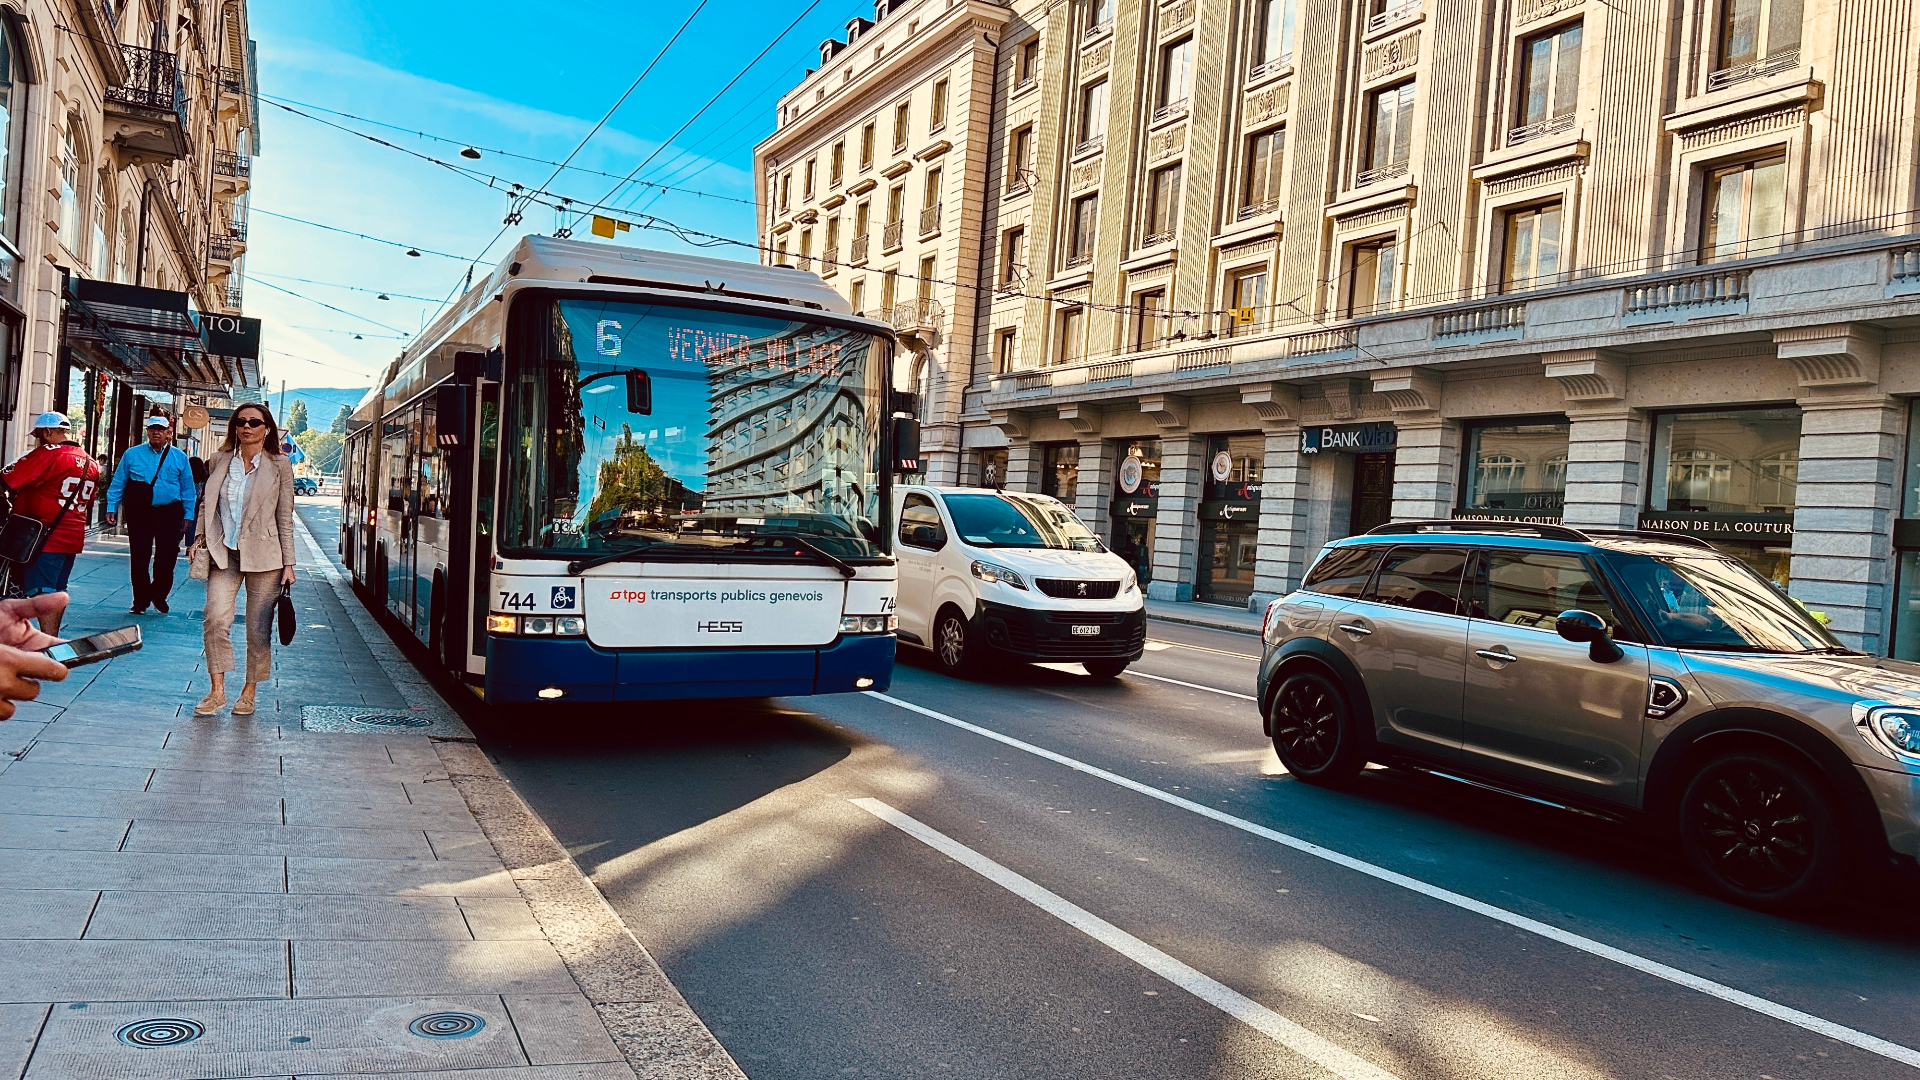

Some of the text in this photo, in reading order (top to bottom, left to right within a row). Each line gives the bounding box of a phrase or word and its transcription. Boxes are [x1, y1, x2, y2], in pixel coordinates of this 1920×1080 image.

[596, 319, 622, 356] 6
[668, 326, 842, 376] VERNIER VILLAGE
[1641, 519, 1689, 530] MAISON
[1693, 521, 1710, 531] DE
[1714, 521, 1730, 532] LA
[499, 591, 537, 611] 744
[622, 589, 823, 604] tpg transports publics genevois
[697, 621, 743, 632] HESS
